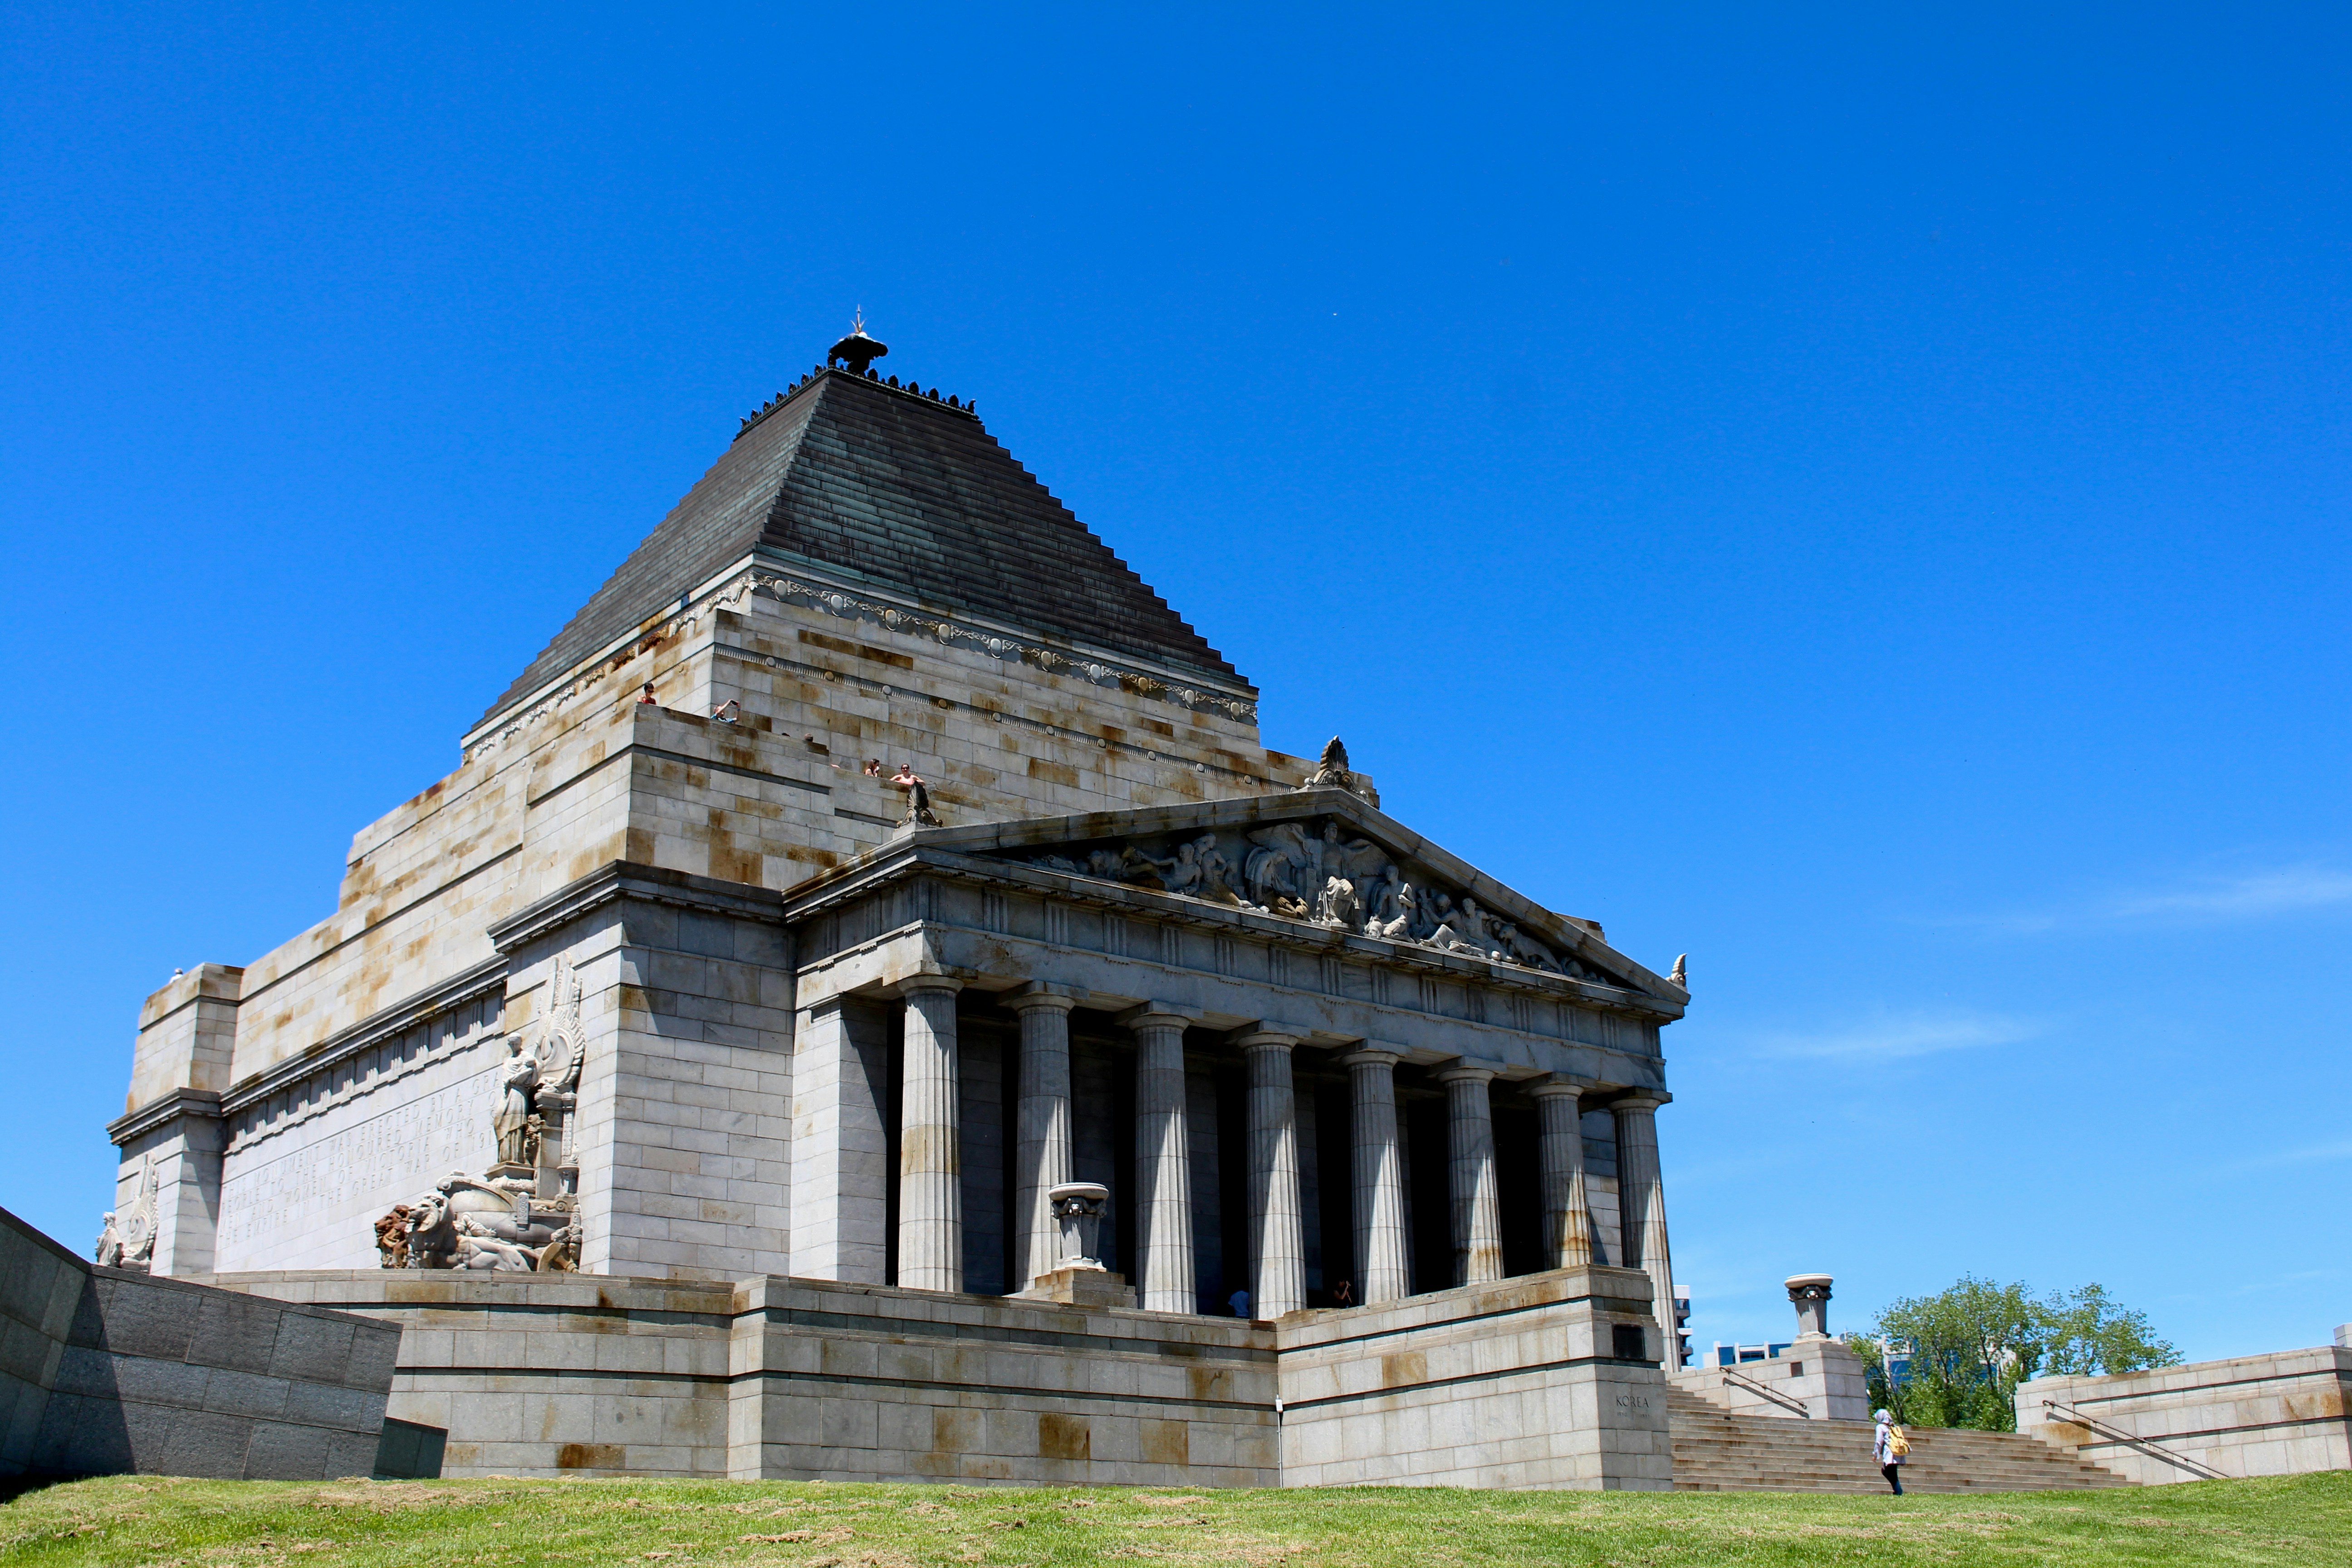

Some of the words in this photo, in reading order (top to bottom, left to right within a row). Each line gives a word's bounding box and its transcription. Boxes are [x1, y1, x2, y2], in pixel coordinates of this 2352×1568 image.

[218, 1229, 237, 1249] THE
[246, 1209, 288, 1238] EMPIRE
[320, 1188, 341, 1209] THE
[353, 1167, 393, 1196] GREAT
[404, 1154, 430, 1173] WAR
[443, 1142, 461, 1162] OF
[471, 1130, 492, 1152] 191
[220, 1212, 241, 1232] MEN
[251, 1199, 273, 1220] AND
[284, 1176, 327, 1203] WOMEN
[338, 1166, 353, 1184] OF
[365, 1136, 430, 1172] VICTORIA
[444, 1117, 475, 1140] WHO
[222, 1188, 260, 1215] PEOPLE
[271, 1178, 284, 1195] TO
[295, 1164, 316, 1185] THE
[329, 1129, 402, 1171] HONOURED
[416, 1099, 474, 1137] MEMORY
[488, 1091, 496, 1107] O
[223, 1177, 246, 1200] THIS
[255, 1145, 320, 1186] MONUMENT
[329, 1132, 351, 1151] WAS
[361, 1104, 420, 1141] ERECTED
[431, 1093, 445, 1112] BY
[455, 1087, 461, 1103] A
[473, 1071, 500, 1095] GRA
[1616, 1395, 1650, 1408] KOREA
